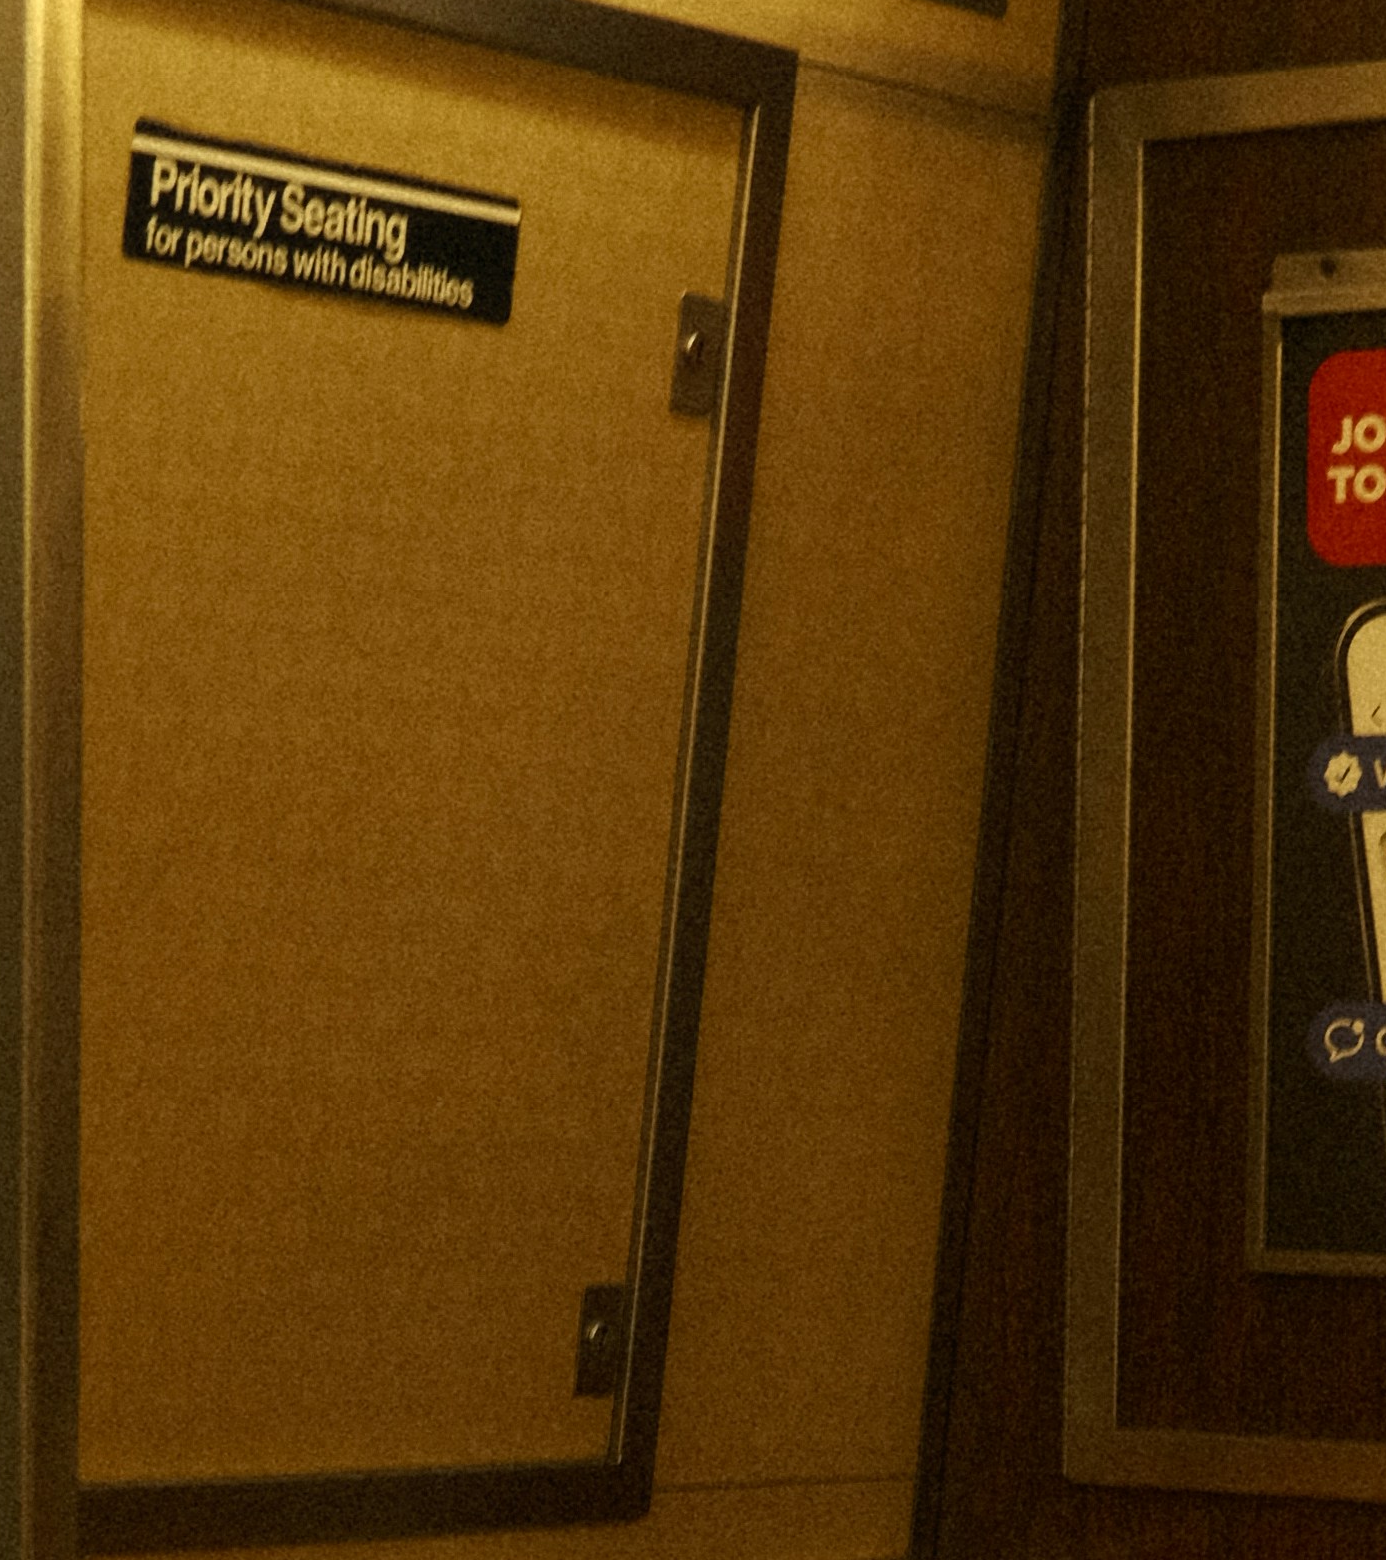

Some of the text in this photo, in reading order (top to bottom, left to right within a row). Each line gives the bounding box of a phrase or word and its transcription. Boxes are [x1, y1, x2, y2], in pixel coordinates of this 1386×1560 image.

[150, 158, 410, 264] Priority Seating
[145, 216, 475, 310] for persons with disabilities
